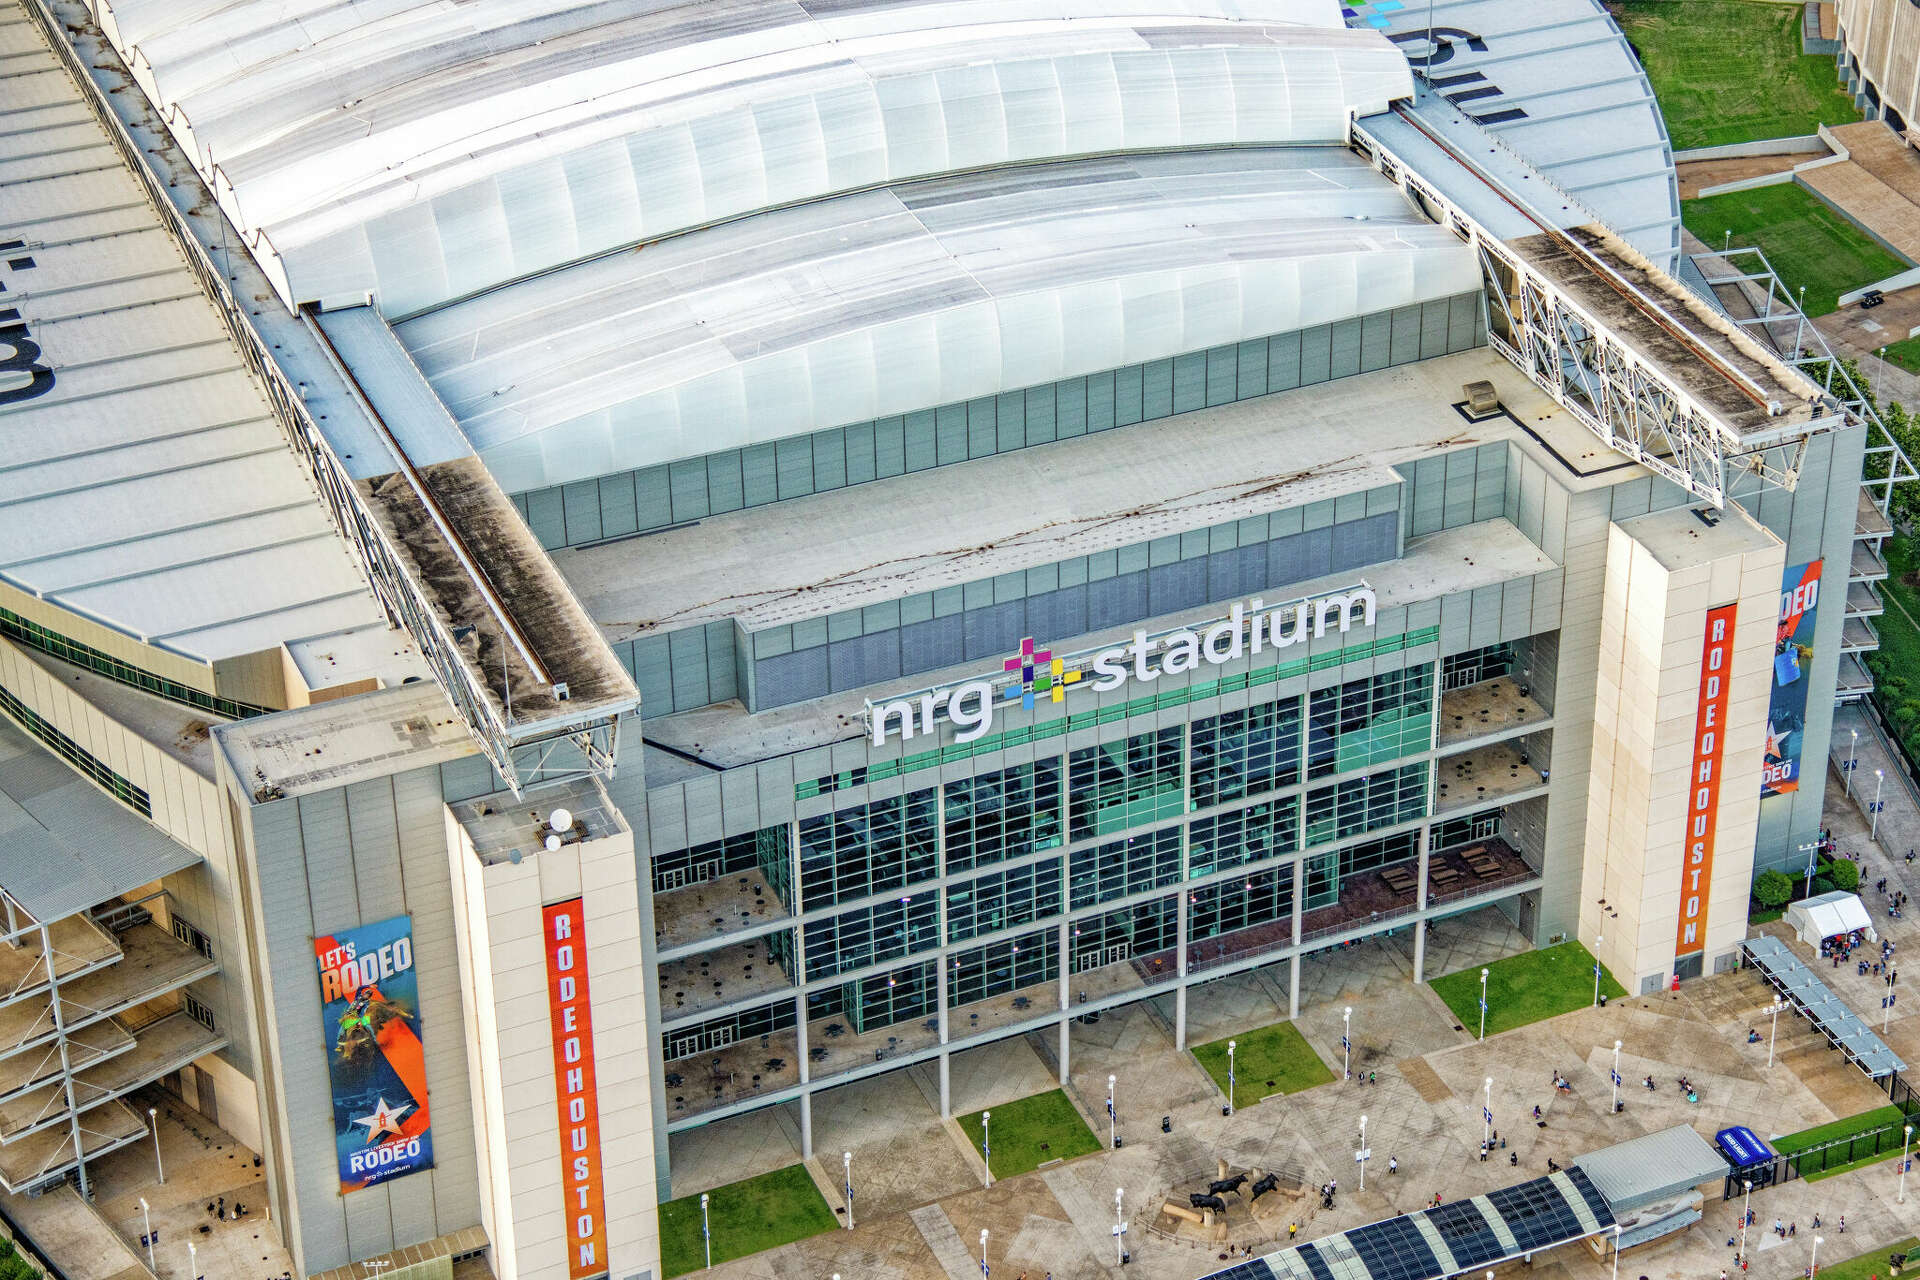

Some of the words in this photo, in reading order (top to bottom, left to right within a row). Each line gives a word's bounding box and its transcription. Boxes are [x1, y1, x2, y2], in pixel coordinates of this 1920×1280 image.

[1778, 579, 1819, 621] DEO
[872, 681, 993, 746] nrg
[1091, 587, 1376, 692] stadium
[1684, 619, 1725, 945] RODEOHOUSTON
[1761, 763, 1792, 784] DEO
[318, 941, 356, 971] LET'S
[321, 937, 412, 1004] RODEO
[554, 913, 596, 1267] RODEOHOUSTON
[350, 1139, 421, 1174] RODEO
